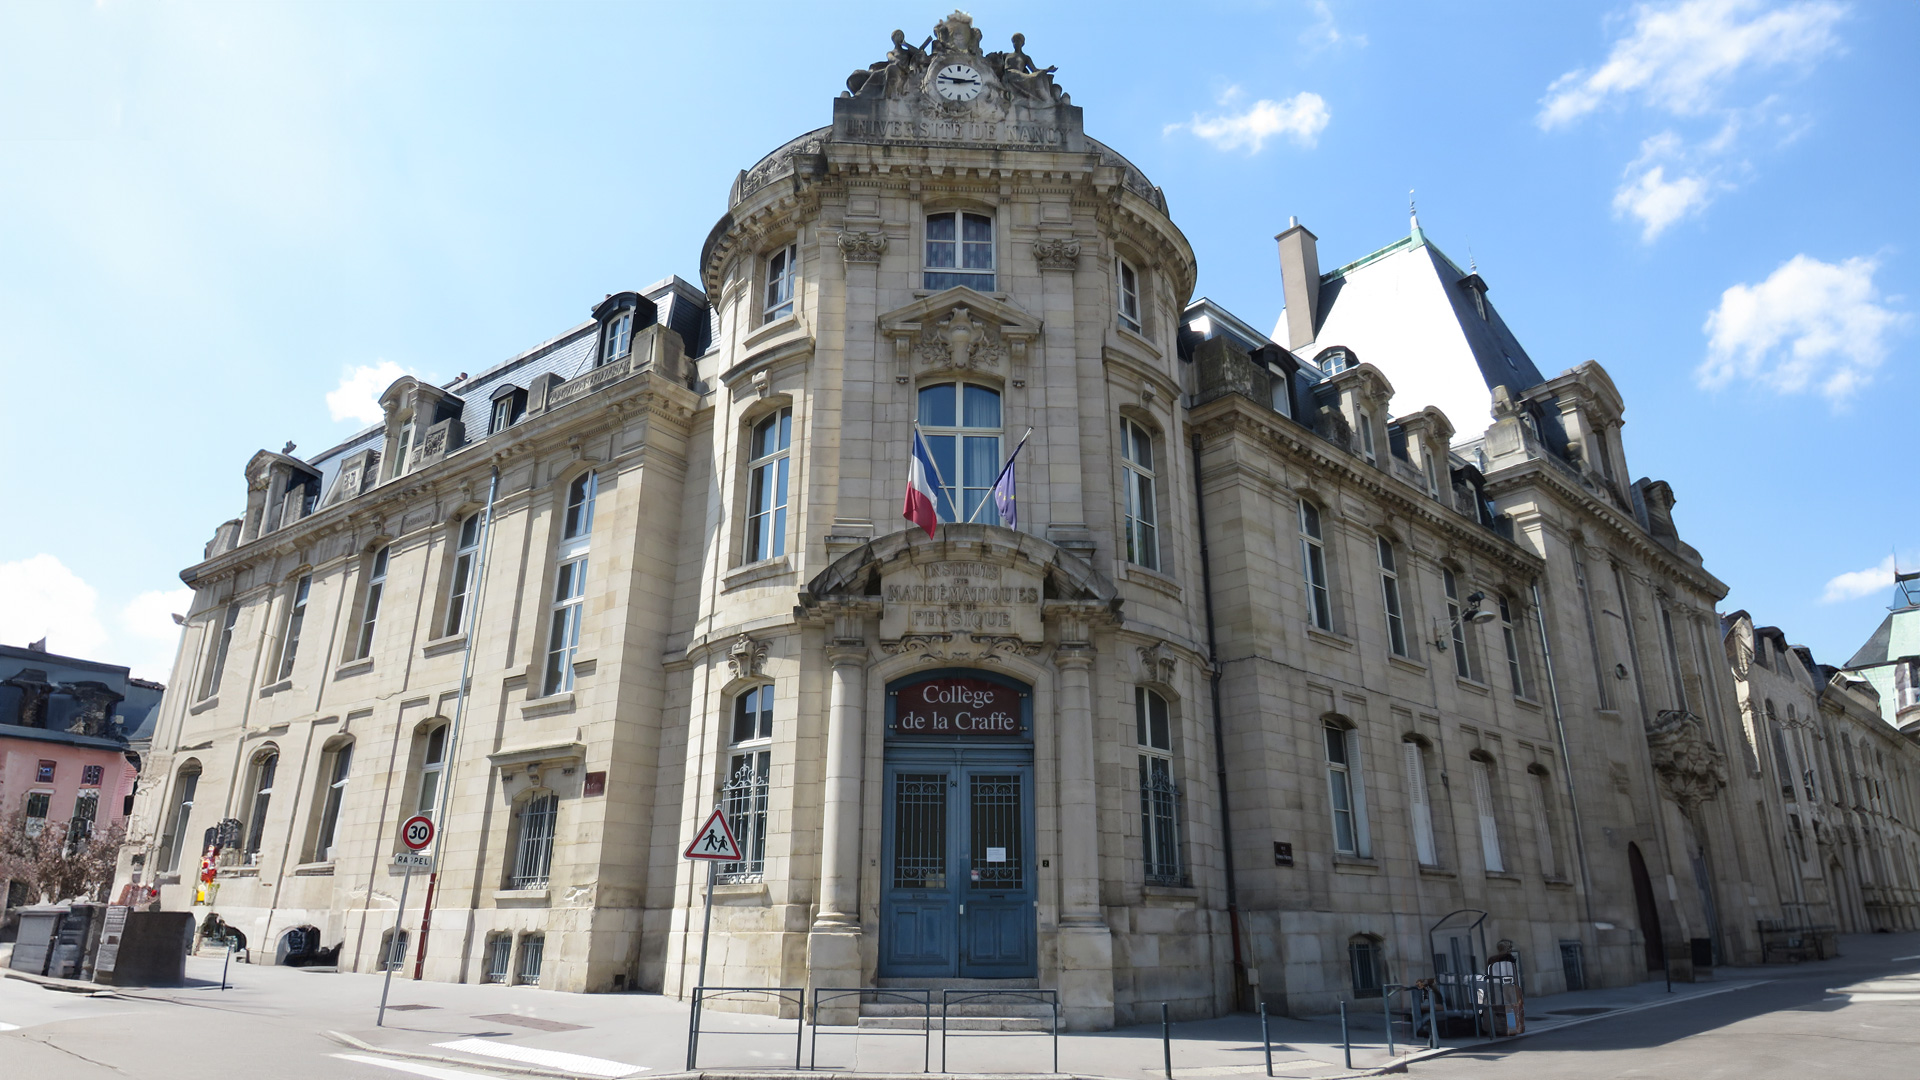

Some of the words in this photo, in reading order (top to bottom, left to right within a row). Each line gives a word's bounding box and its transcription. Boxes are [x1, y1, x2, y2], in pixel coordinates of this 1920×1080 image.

[971, 123, 997, 141] DE
[1006, 125, 1073, 145] NANCY
[912, 611, 1011, 630] PHYSIQUE
[923, 685, 994, 708] Collège
[902, 711, 926, 730] de
[932, 711, 949, 730] la
[955, 711, 1015, 730] Craffe
[409, 825, 428, 840] 30
